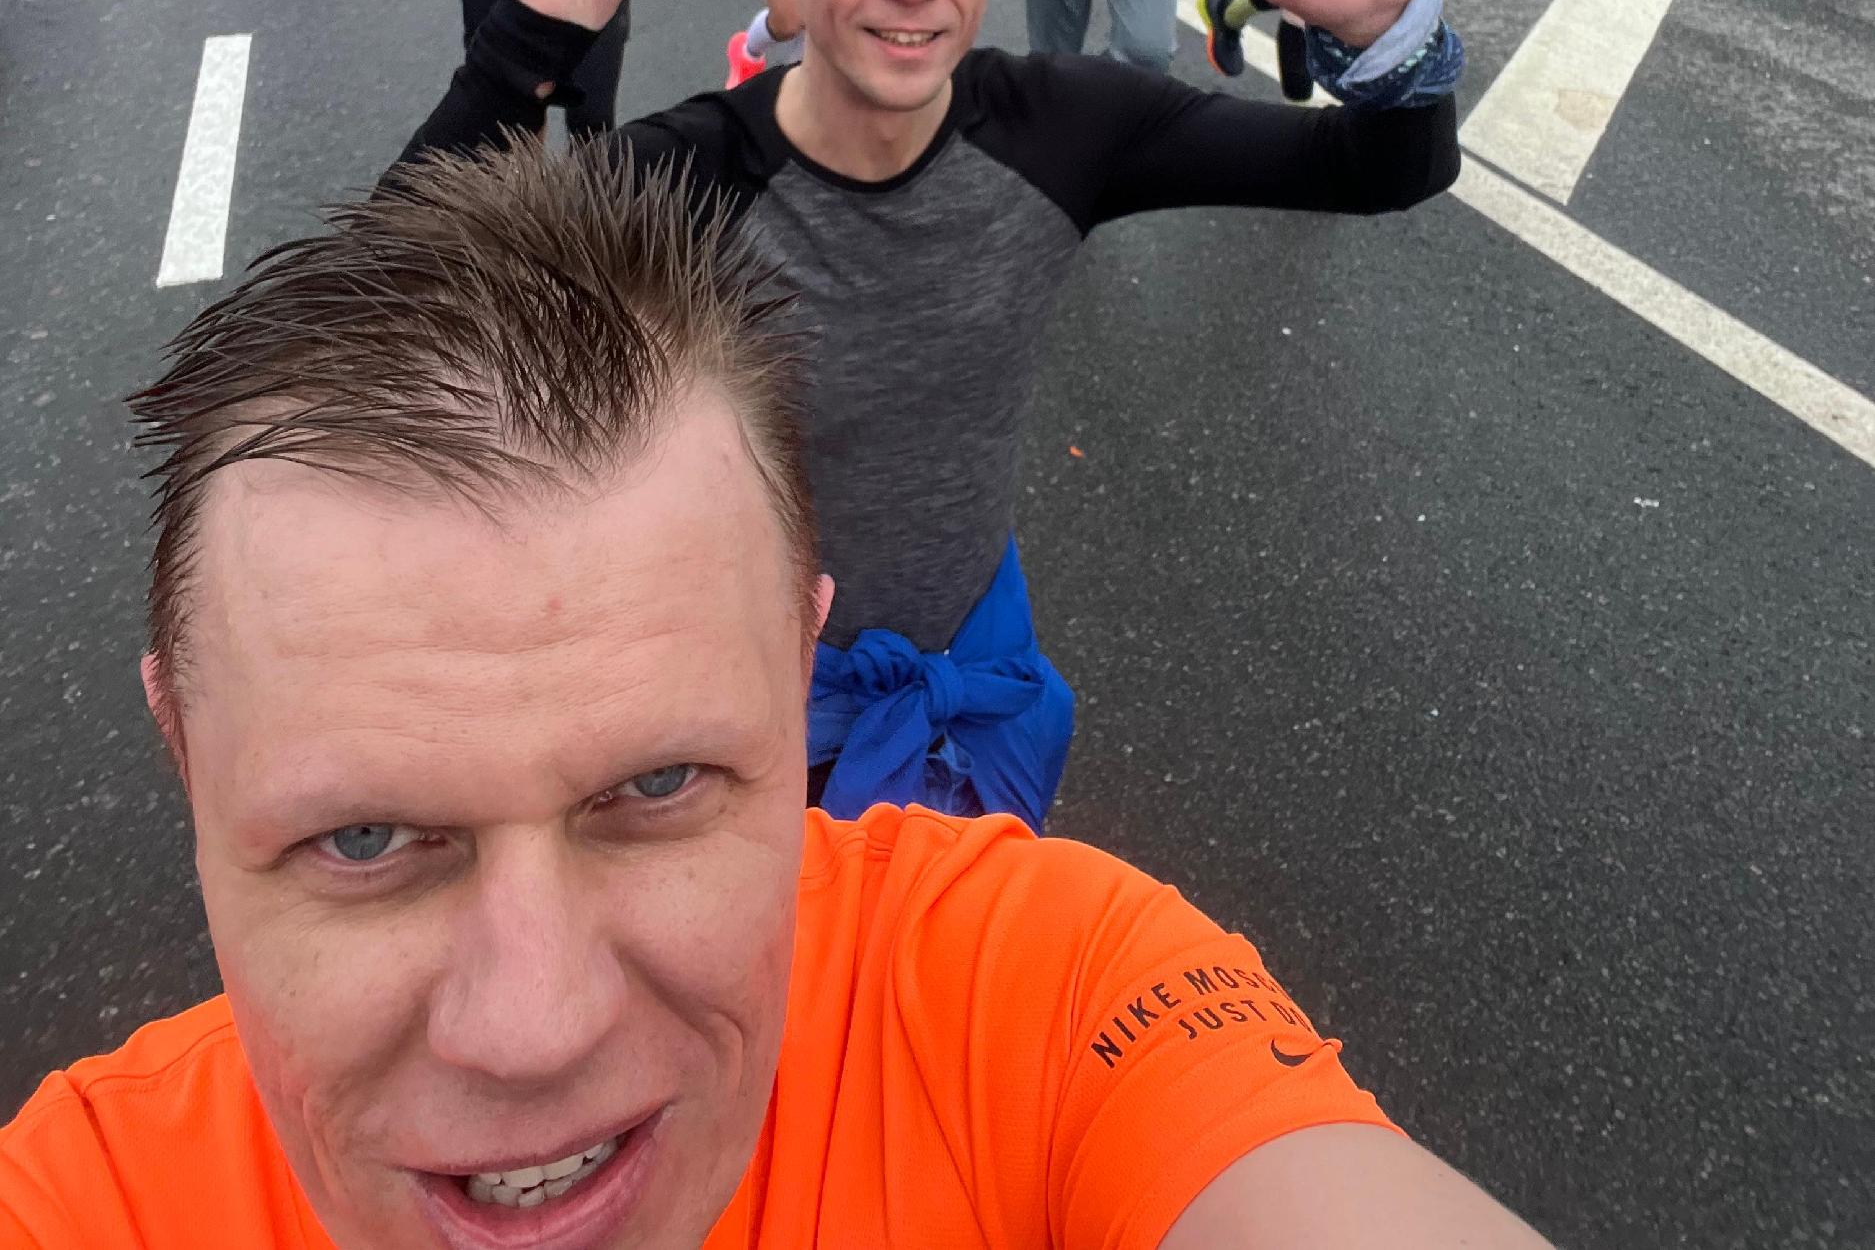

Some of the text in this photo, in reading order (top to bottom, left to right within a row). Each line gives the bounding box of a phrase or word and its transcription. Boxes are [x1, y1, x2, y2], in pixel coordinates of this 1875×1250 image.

[1090, 965, 1291, 1069] NIKE MOSC
[1177, 999, 1268, 1040] JUST
